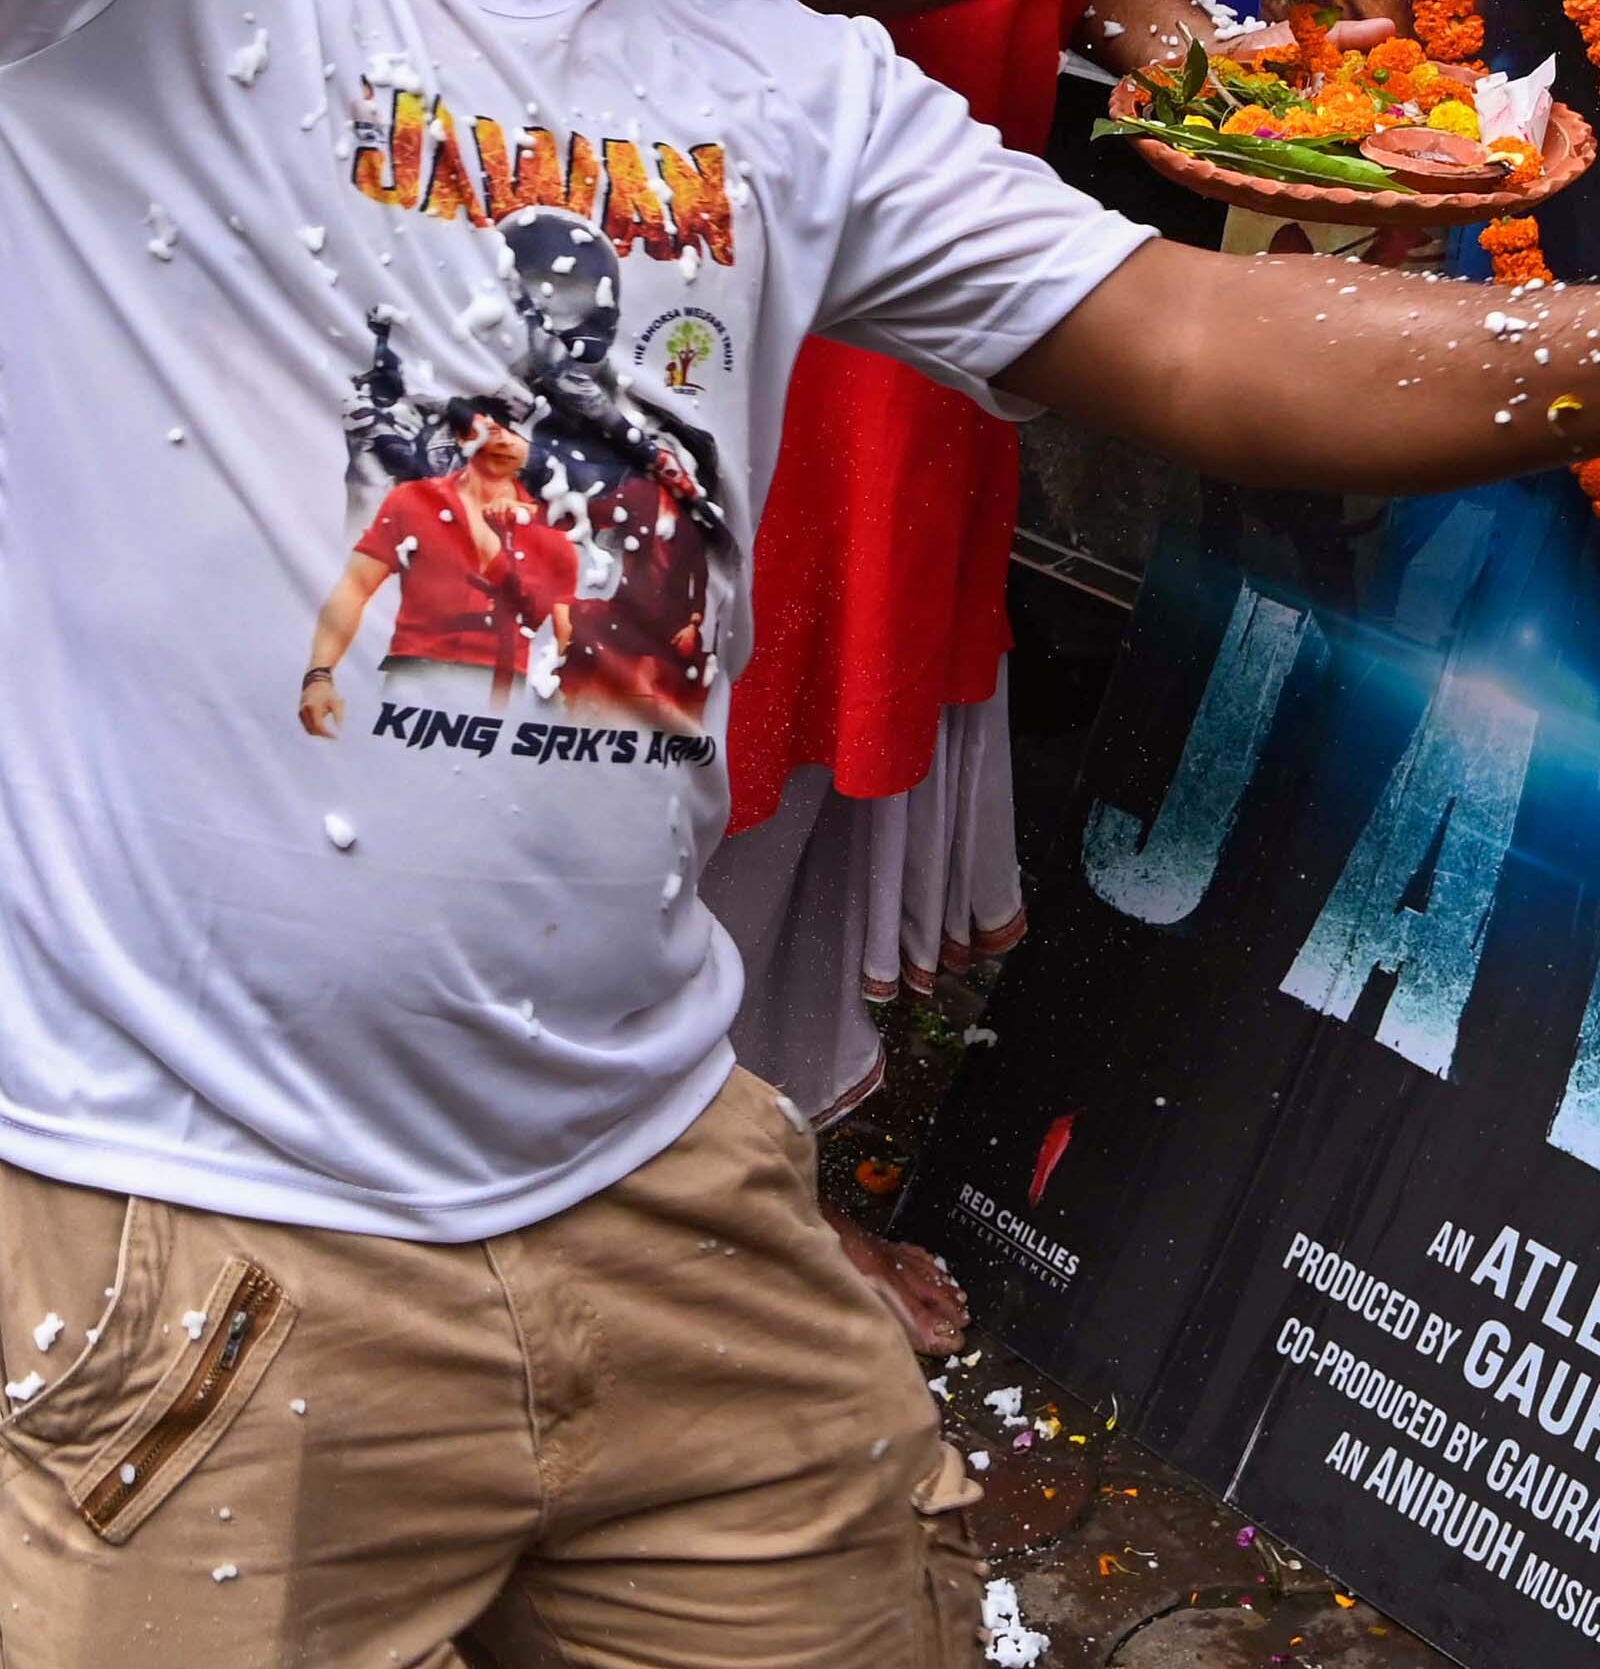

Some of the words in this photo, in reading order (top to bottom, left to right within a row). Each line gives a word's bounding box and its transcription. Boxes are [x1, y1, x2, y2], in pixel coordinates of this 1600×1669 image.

[351, 89, 735, 266] JAWAN
[372, 701, 504, 758] KING
[511, 722, 639, 765] SRK'S
[959, 1183, 995, 1217] RED
[996, 1209, 1080, 1276] CHILLIES
[1426, 1220, 1476, 1273] AN
[1282, 1231, 1421, 1341] PRODUCED
[1415, 1314, 1463, 1364] BY
[1276, 1317, 1447, 1450] CO-PRODUCED
[1443, 1422, 1488, 1472] BY
[1325, 1431, 1370, 1482] AN
[1363, 1446, 1525, 1581] ANIRUDH
